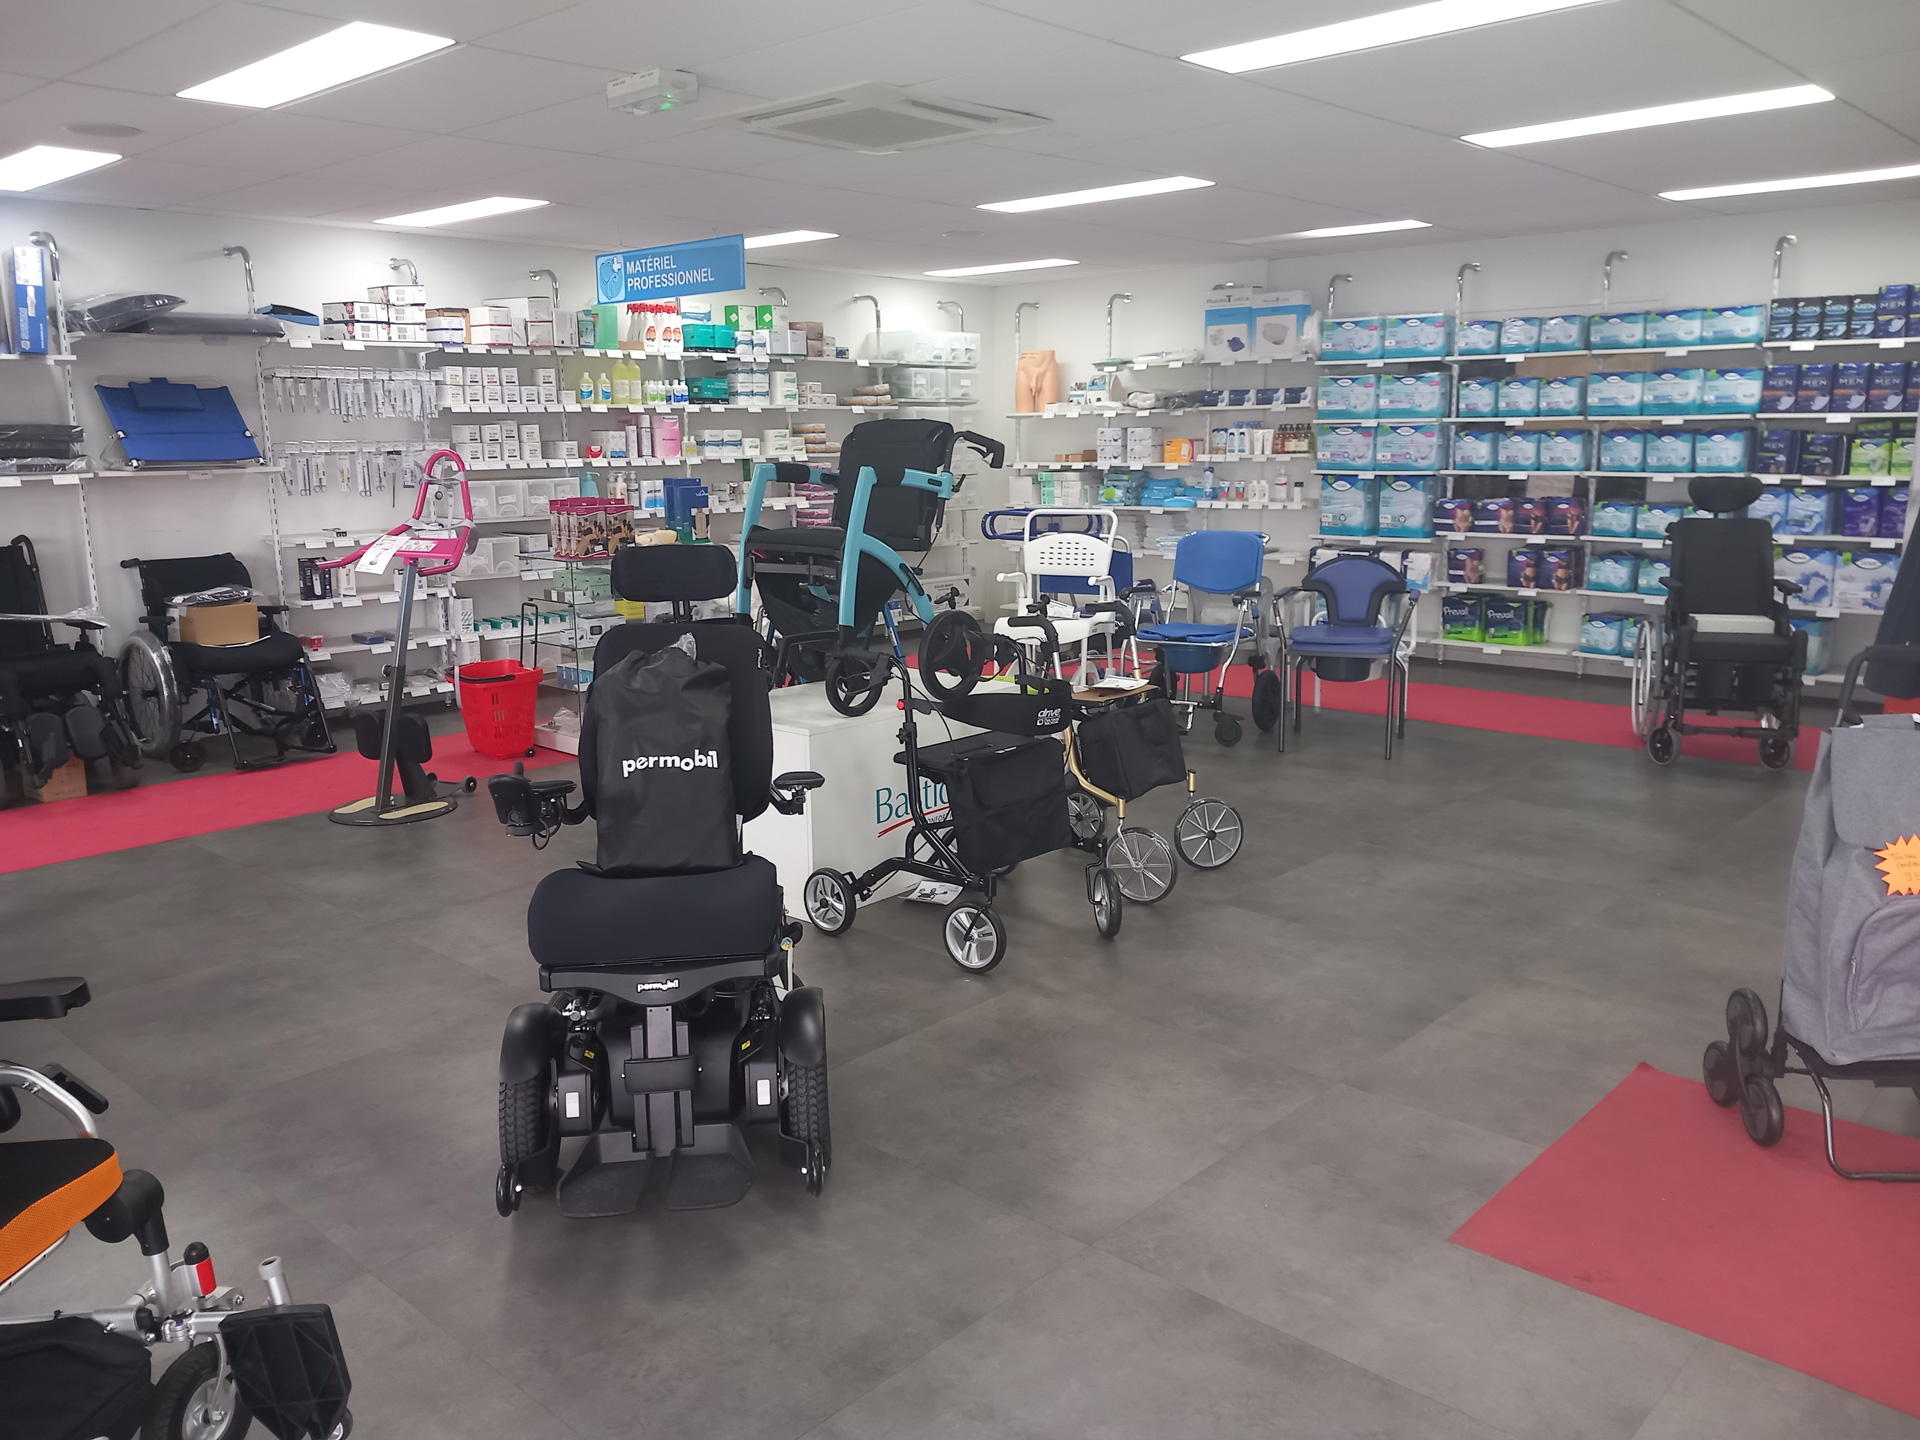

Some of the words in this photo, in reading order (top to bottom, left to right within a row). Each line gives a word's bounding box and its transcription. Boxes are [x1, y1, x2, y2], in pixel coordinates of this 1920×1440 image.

[626, 255, 677, 275] MATÉRIEL
[627, 268, 715, 291] PROFESSIONNEL
[1880, 300, 1906, 309] MEN
[1443, 606, 1469, 616] Prevail
[1487, 609, 1514, 619] Prevail
[622, 749, 719, 778] permobil
[876, 779, 950, 825] Bati
[637, 979, 679, 993] permobil
